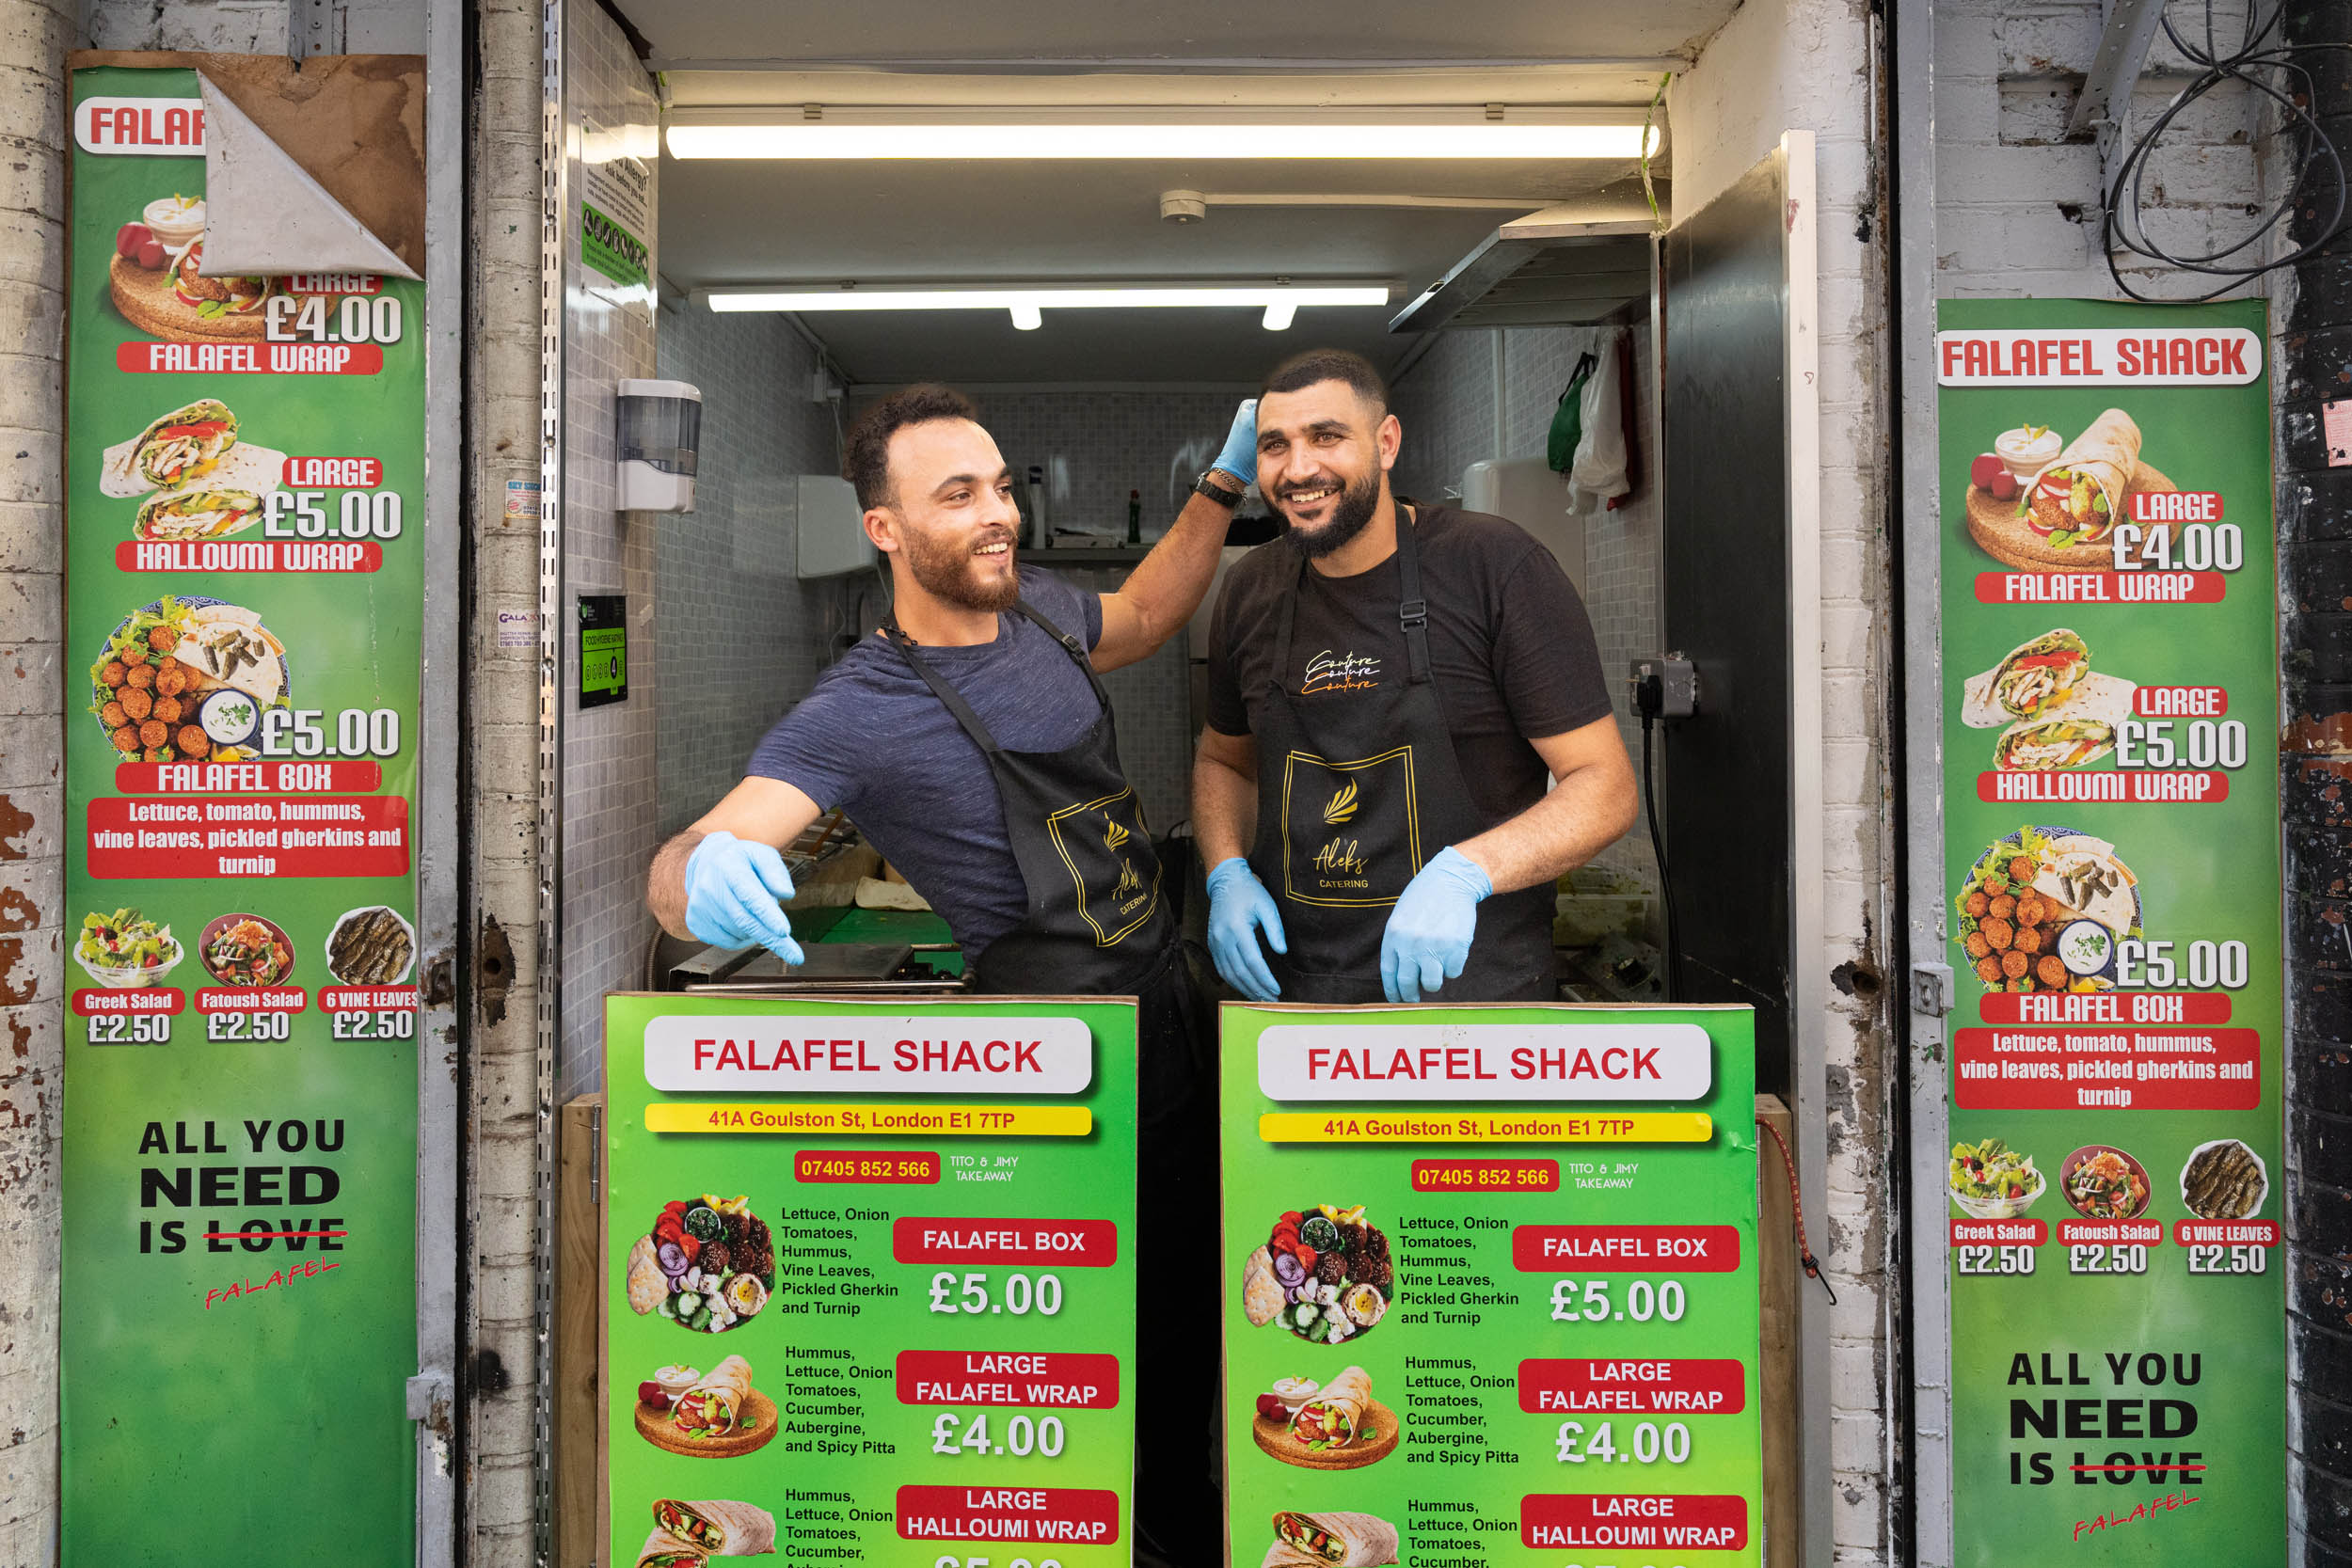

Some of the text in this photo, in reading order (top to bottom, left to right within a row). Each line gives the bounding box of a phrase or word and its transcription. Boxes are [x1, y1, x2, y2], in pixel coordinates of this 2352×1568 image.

[293, 276, 375, 294] LARGE
[264, 295, 402, 343] £4.00
[150, 343, 351, 372] FALAFEL WRAP
[1942, 338, 2247, 377] FALAFEL SHACK
[291, 458, 374, 486] LARGE
[261, 489, 402, 538] £5.00
[2136, 493, 2217, 521] LARGE
[136, 543, 364, 571] HALLOUMI WRAP
[2111, 523, 2243, 571] £4.00
[2006, 573, 2195, 601] FALAFEL WRAP
[1304, 659, 1380, 684] Couture
[1306, 649, 1381, 673] Couture
[1301, 671, 1379, 695] Couture
[2140, 688, 2220, 716] LARGE
[260, 707, 399, 756] £5.00
[2113, 720, 2247, 768] £5.00
[158, 763, 332, 791] FALAFEL BOX
[1996, 772, 2211, 800] HALLOUMI WRAP
[129, 801, 365, 823] Lettuce, tomato, hummus,
[93, 827, 402, 850] vine leaves, pickled gherkins and
[218, 854, 276, 876] turnip
[1311, 836, 1369, 876] Aleks
[1319, 879, 1370, 889] CATERING
[2114, 939, 2248, 988] £5.00
[85, 992, 172, 1009] Greek Salad
[202, 991, 304, 1008] Fatoush Salad
[326, 992, 337, 1007] 6
[338, 991, 371, 1007] VINE
[2020, 994, 2184, 1022] FALAFEL BOX
[87, 1014, 170, 1042] £2.50
[207, 1011, 289, 1040] £2.50
[332, 1009, 413, 1038] £2.50
[693, 1038, 1042, 1073] FALAFEL SHACK
[1993, 1033, 2217, 1054] Lettuce, tomato, hummus,
[1309, 1047, 1662, 1081] FALAFEL SHACK
[1960, 1059, 2253, 1082] vine leaves, pickled gherkins and
[2076, 1086, 2132, 1107] turnip
[708, 1110, 1015, 1130] 41A Goulston St, London E1 7TP
[1324, 1119, 1634, 1138] 41A Goulston St, London E1 7TP
[137, 1118, 344, 1155] ALL YOU
[802, 1160, 930, 1178] 07405 852 566
[949, 1155, 1020, 1167] TITO & JIMY
[140, 1165, 341, 1208] NEED
[955, 1170, 1014, 1182] TAKEAWAY
[1419, 1169, 1549, 1185] 07405 852 566
[782, 1207, 889, 1222] Lettuce, Onion
[139, 1218, 344, 1255] IS LOVE
[781, 1226, 857, 1242] Tomatoes,
[924, 1230, 1085, 1251] FALAFEL BOX
[1954, 1224, 2036, 1240] Greek Salad
[2064, 1224, 2160, 1241] Fatoush Salad
[2182, 1226, 2273, 1242] 6 VINE LEAVES
[782, 1244, 851, 1260] Hummus,
[1544, 1238, 1708, 1258] FALAFEL BOX
[1958, 1245, 2034, 1274] £2.50
[2069, 1244, 2147, 1273] £2.50
[2188, 1245, 2265, 1273] £2.50
[204, 1256, 340, 1310] FALAFEL
[781, 1263, 875, 1279] Vine Leaves,
[782, 1282, 898, 1296] Pickled Gherkin
[929, 1271, 1062, 1316] £5.00
[1549, 1279, 1685, 1322] £5.00
[782, 1301, 861, 1318] and Turnip
[786, 1364, 893, 1380] Lettuce, Onion
[966, 1354, 1047, 1375] LARGE
[1589, 1362, 1672, 1382] LARGE
[2007, 1353, 2201, 1386] ALL YOU
[916, 1382, 1098, 1404] FALAFEL WRAP
[1539, 1390, 1723, 1410] FALAFEL WRAP
[786, 1402, 865, 1418] Cucumber,
[2010, 1399, 2199, 1439] NEED
[785, 1420, 866, 1437] Aubergine,
[931, 1413, 1064, 1457] £4.00
[786, 1439, 896, 1456] and Spicy Pitta
[1555, 1421, 1691, 1464] £4.00
[2010, 1451, 2203, 1486] IS LOVE
[966, 1490, 1047, 1511] LARGE
[2073, 1489, 2201, 1542] FALAFEL
[908, 1516, 1106, 1541] HALLOUMI WRAP
